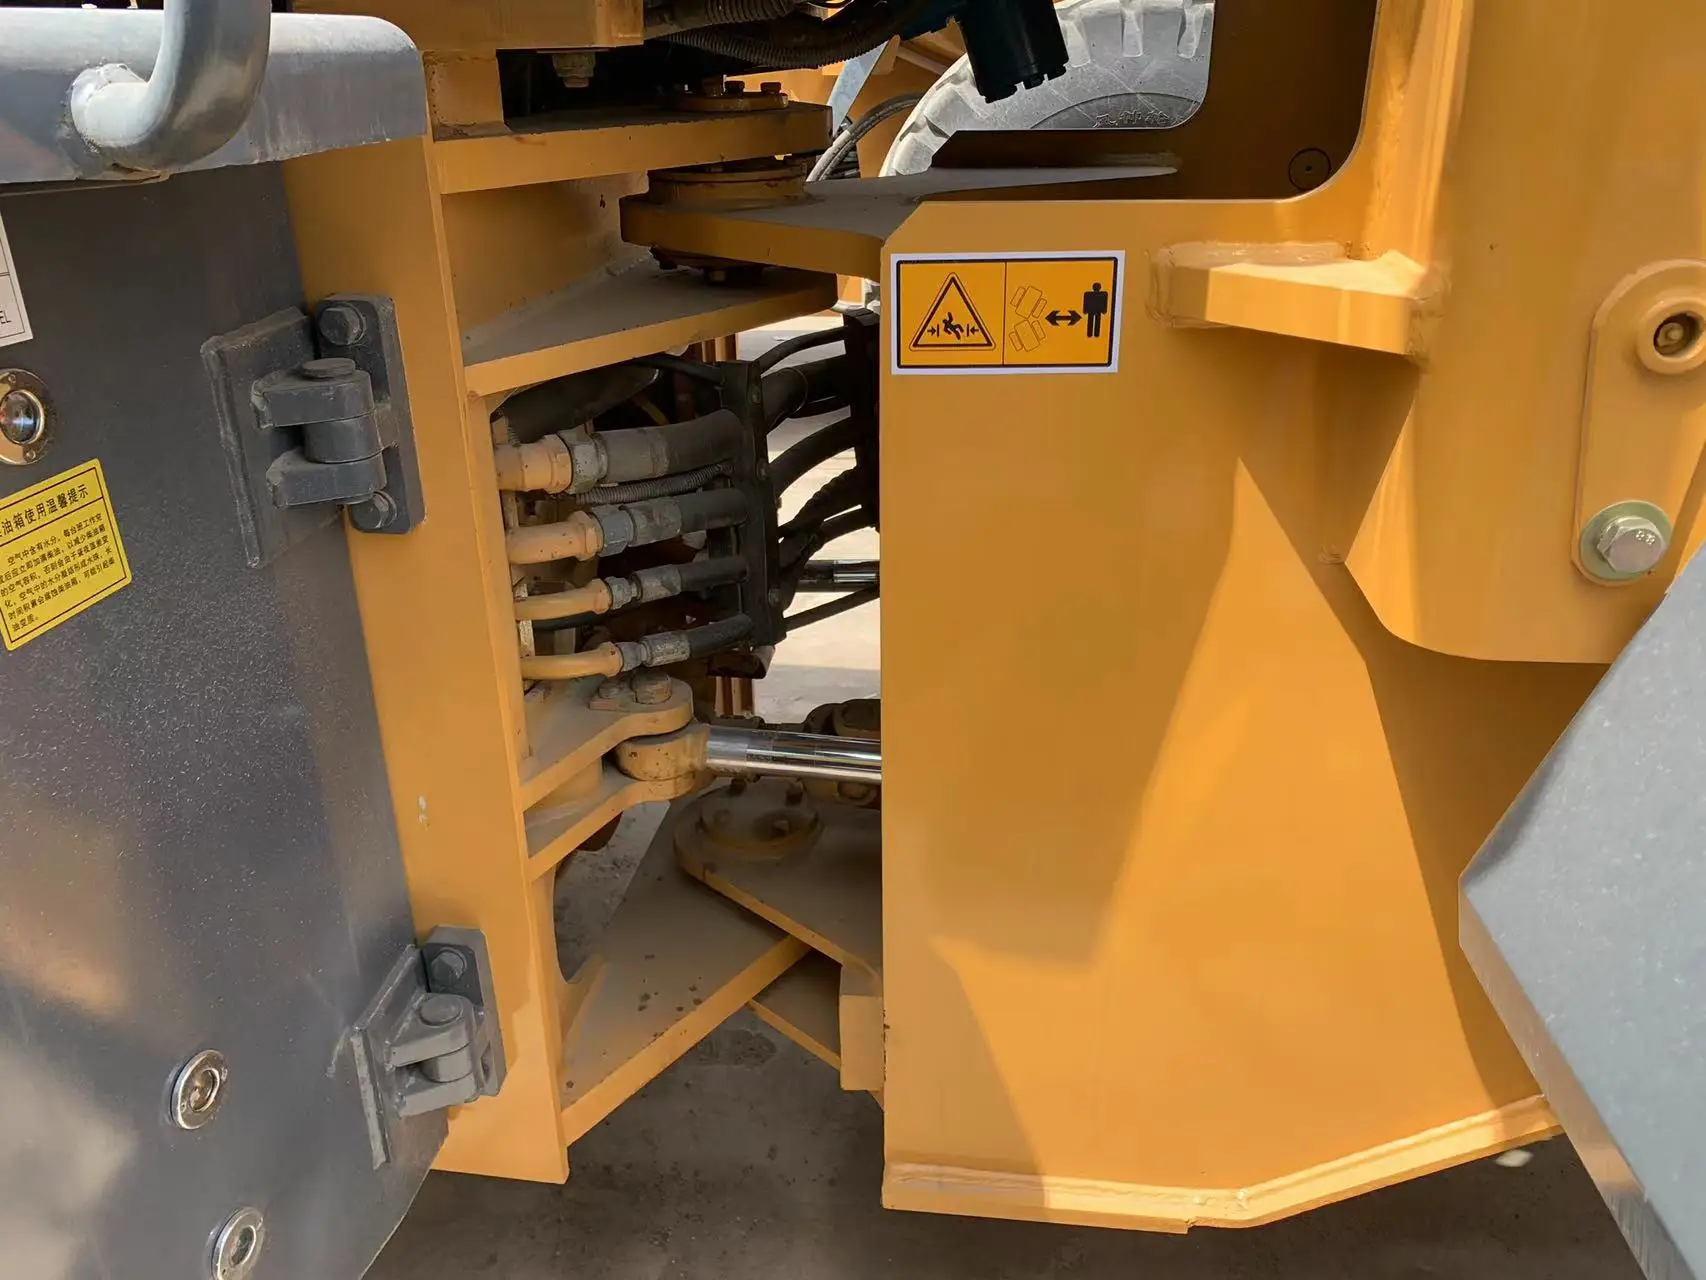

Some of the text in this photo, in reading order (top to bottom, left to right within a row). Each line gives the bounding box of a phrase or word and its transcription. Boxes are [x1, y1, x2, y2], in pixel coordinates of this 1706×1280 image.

[0, 484, 88, 537] 油箱使用温馨提示
